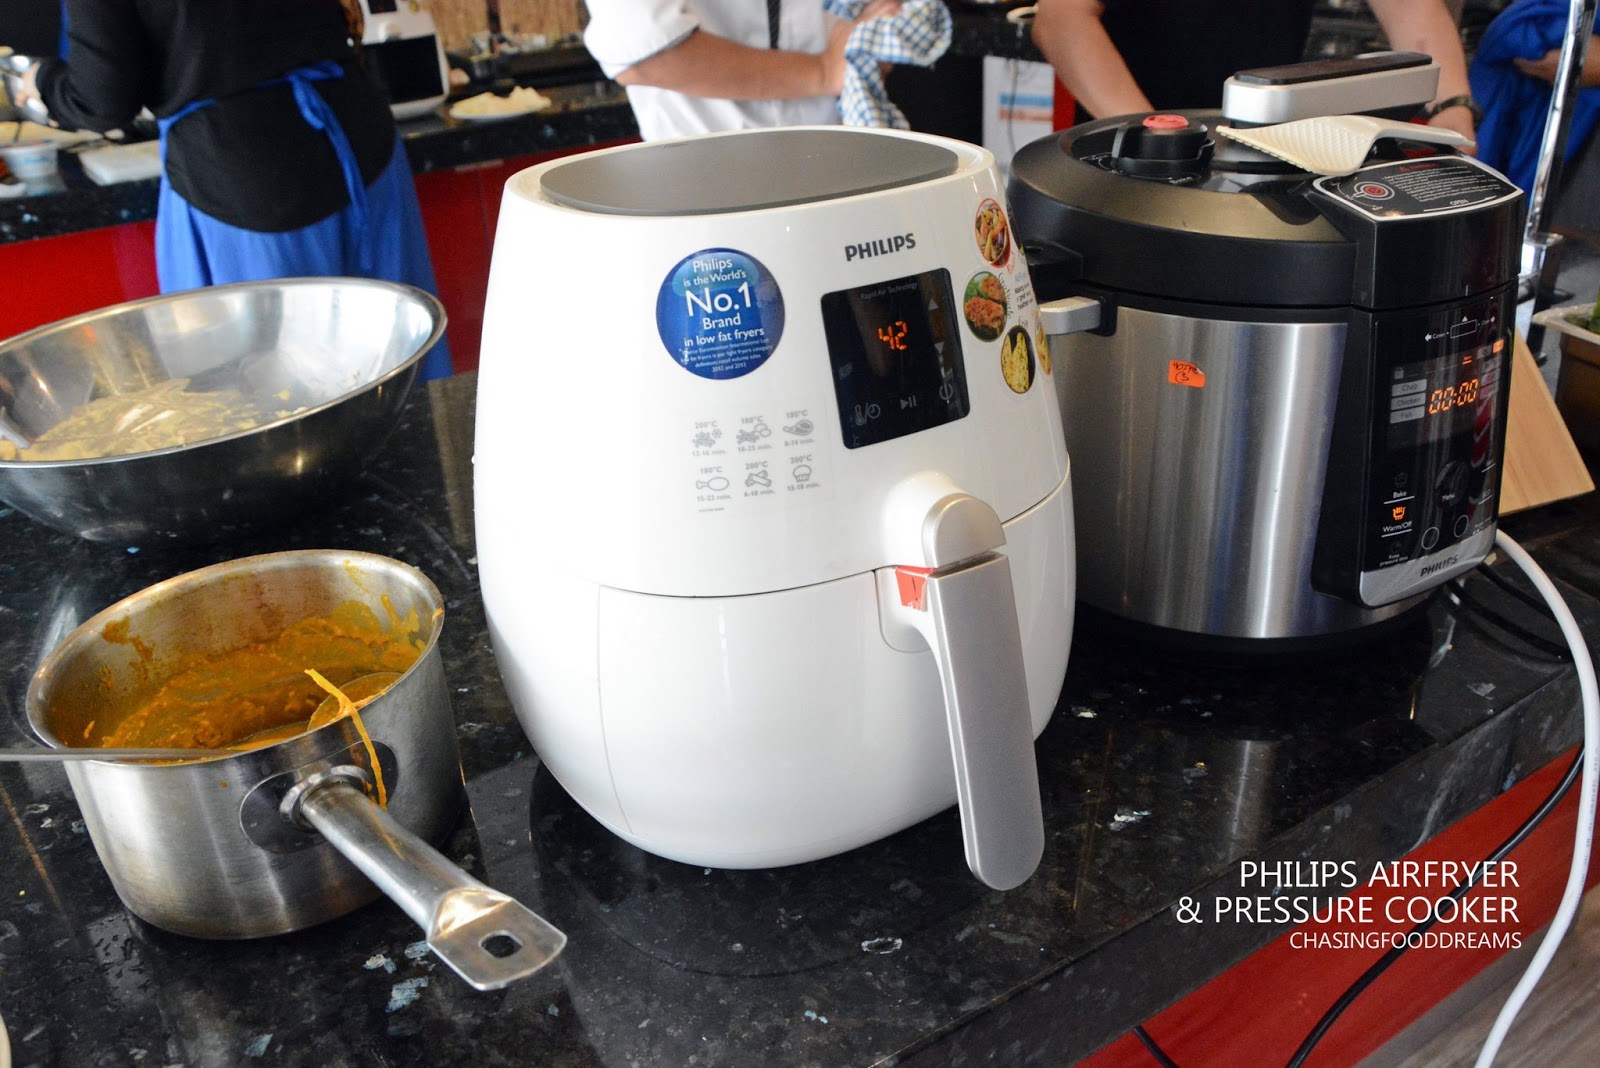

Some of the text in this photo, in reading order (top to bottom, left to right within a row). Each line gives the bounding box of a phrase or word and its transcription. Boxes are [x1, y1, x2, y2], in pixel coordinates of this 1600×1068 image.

[844, 233, 916, 262] PHILIPS
[692, 258, 733, 273] Philips
[683, 269, 747, 287] is the World's
[685, 281, 751, 317] No.1
[861, 281, 919, 300] Rapid Air Technology
[702, 312, 741, 330] Brand
[683, 327, 765, 347] in low fat fryers
[878, 320, 909, 350] 42
[1429, 379, 1479, 414] 00:00
[1393, 491, 1407, 499] Bake
[1382, 520, 1412, 533] Warm/Off
[1420, 554, 1459, 577] PHILIPS
